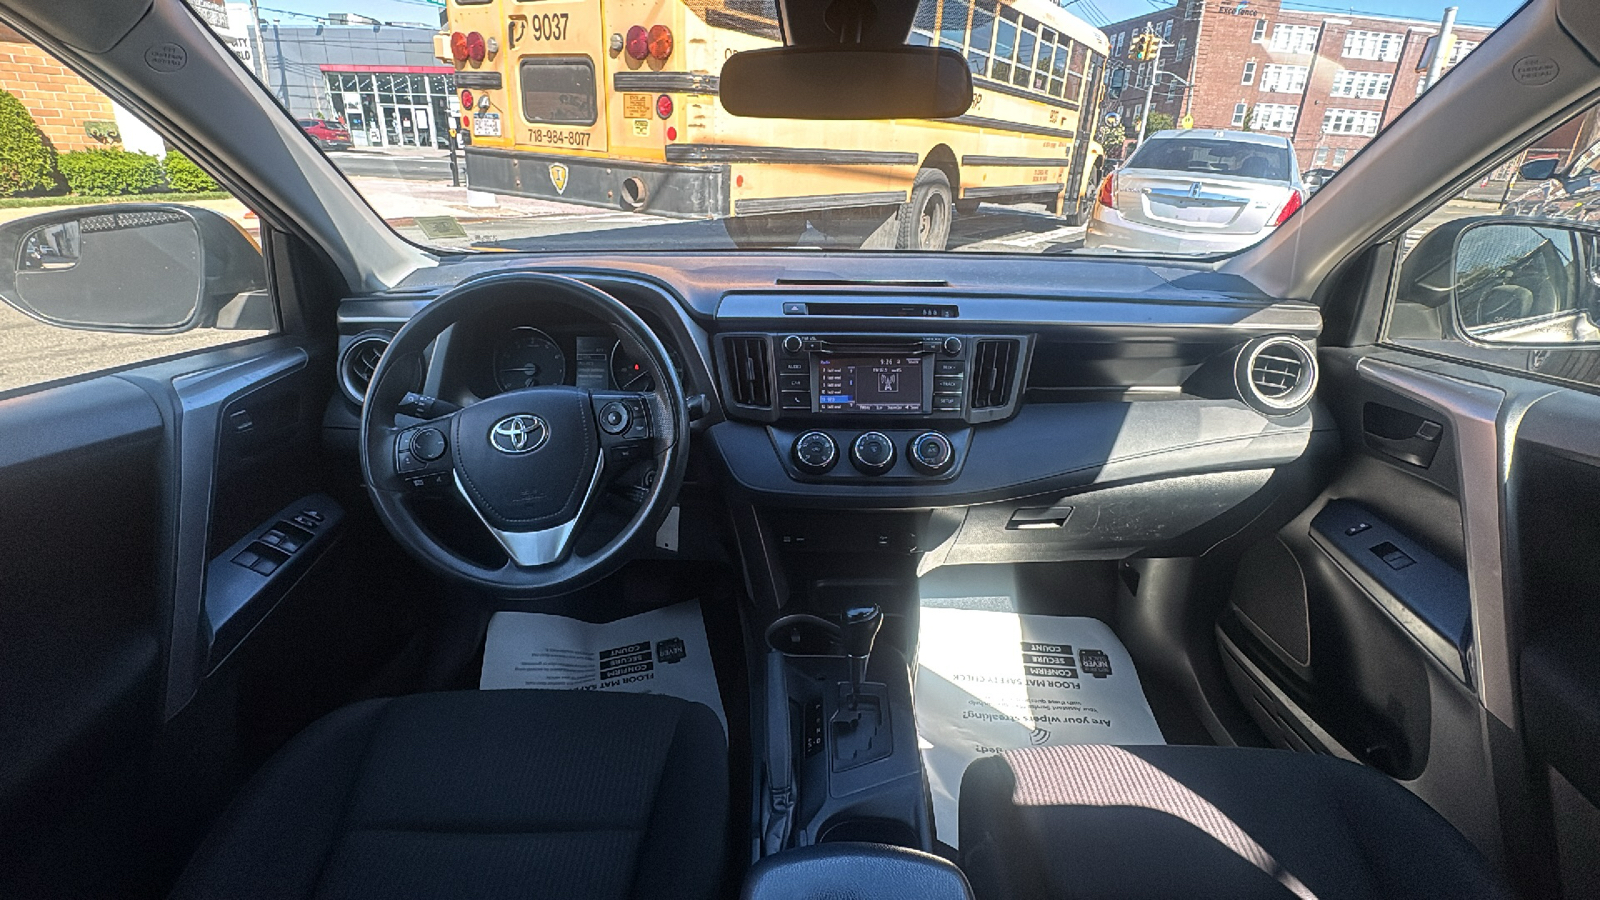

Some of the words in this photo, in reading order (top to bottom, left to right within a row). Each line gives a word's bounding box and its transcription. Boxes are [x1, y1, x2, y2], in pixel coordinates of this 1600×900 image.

[532, 13, 569, 41] 9037
[527, 129, 591, 147] 718-984-8077
[611, 645, 641, 657] COUNT
[1031, 644, 1062, 653] COUNT
[1032, 655, 1066, 664] SECURE
[1082, 659, 1109, 668] NEVER
[606, 664, 648, 678] CONFIRM
[1030, 667, 1072, 677] CONFIRM
[622, 672, 654, 684] FLOOR
[1025, 679, 1046, 687] MAT
[1047, 680, 1081, 690] FLOOR
[1023, 714, 1061, 725] wipers
[1063, 715, 1090, 724] your
[1091, 719, 1112, 728] Are
